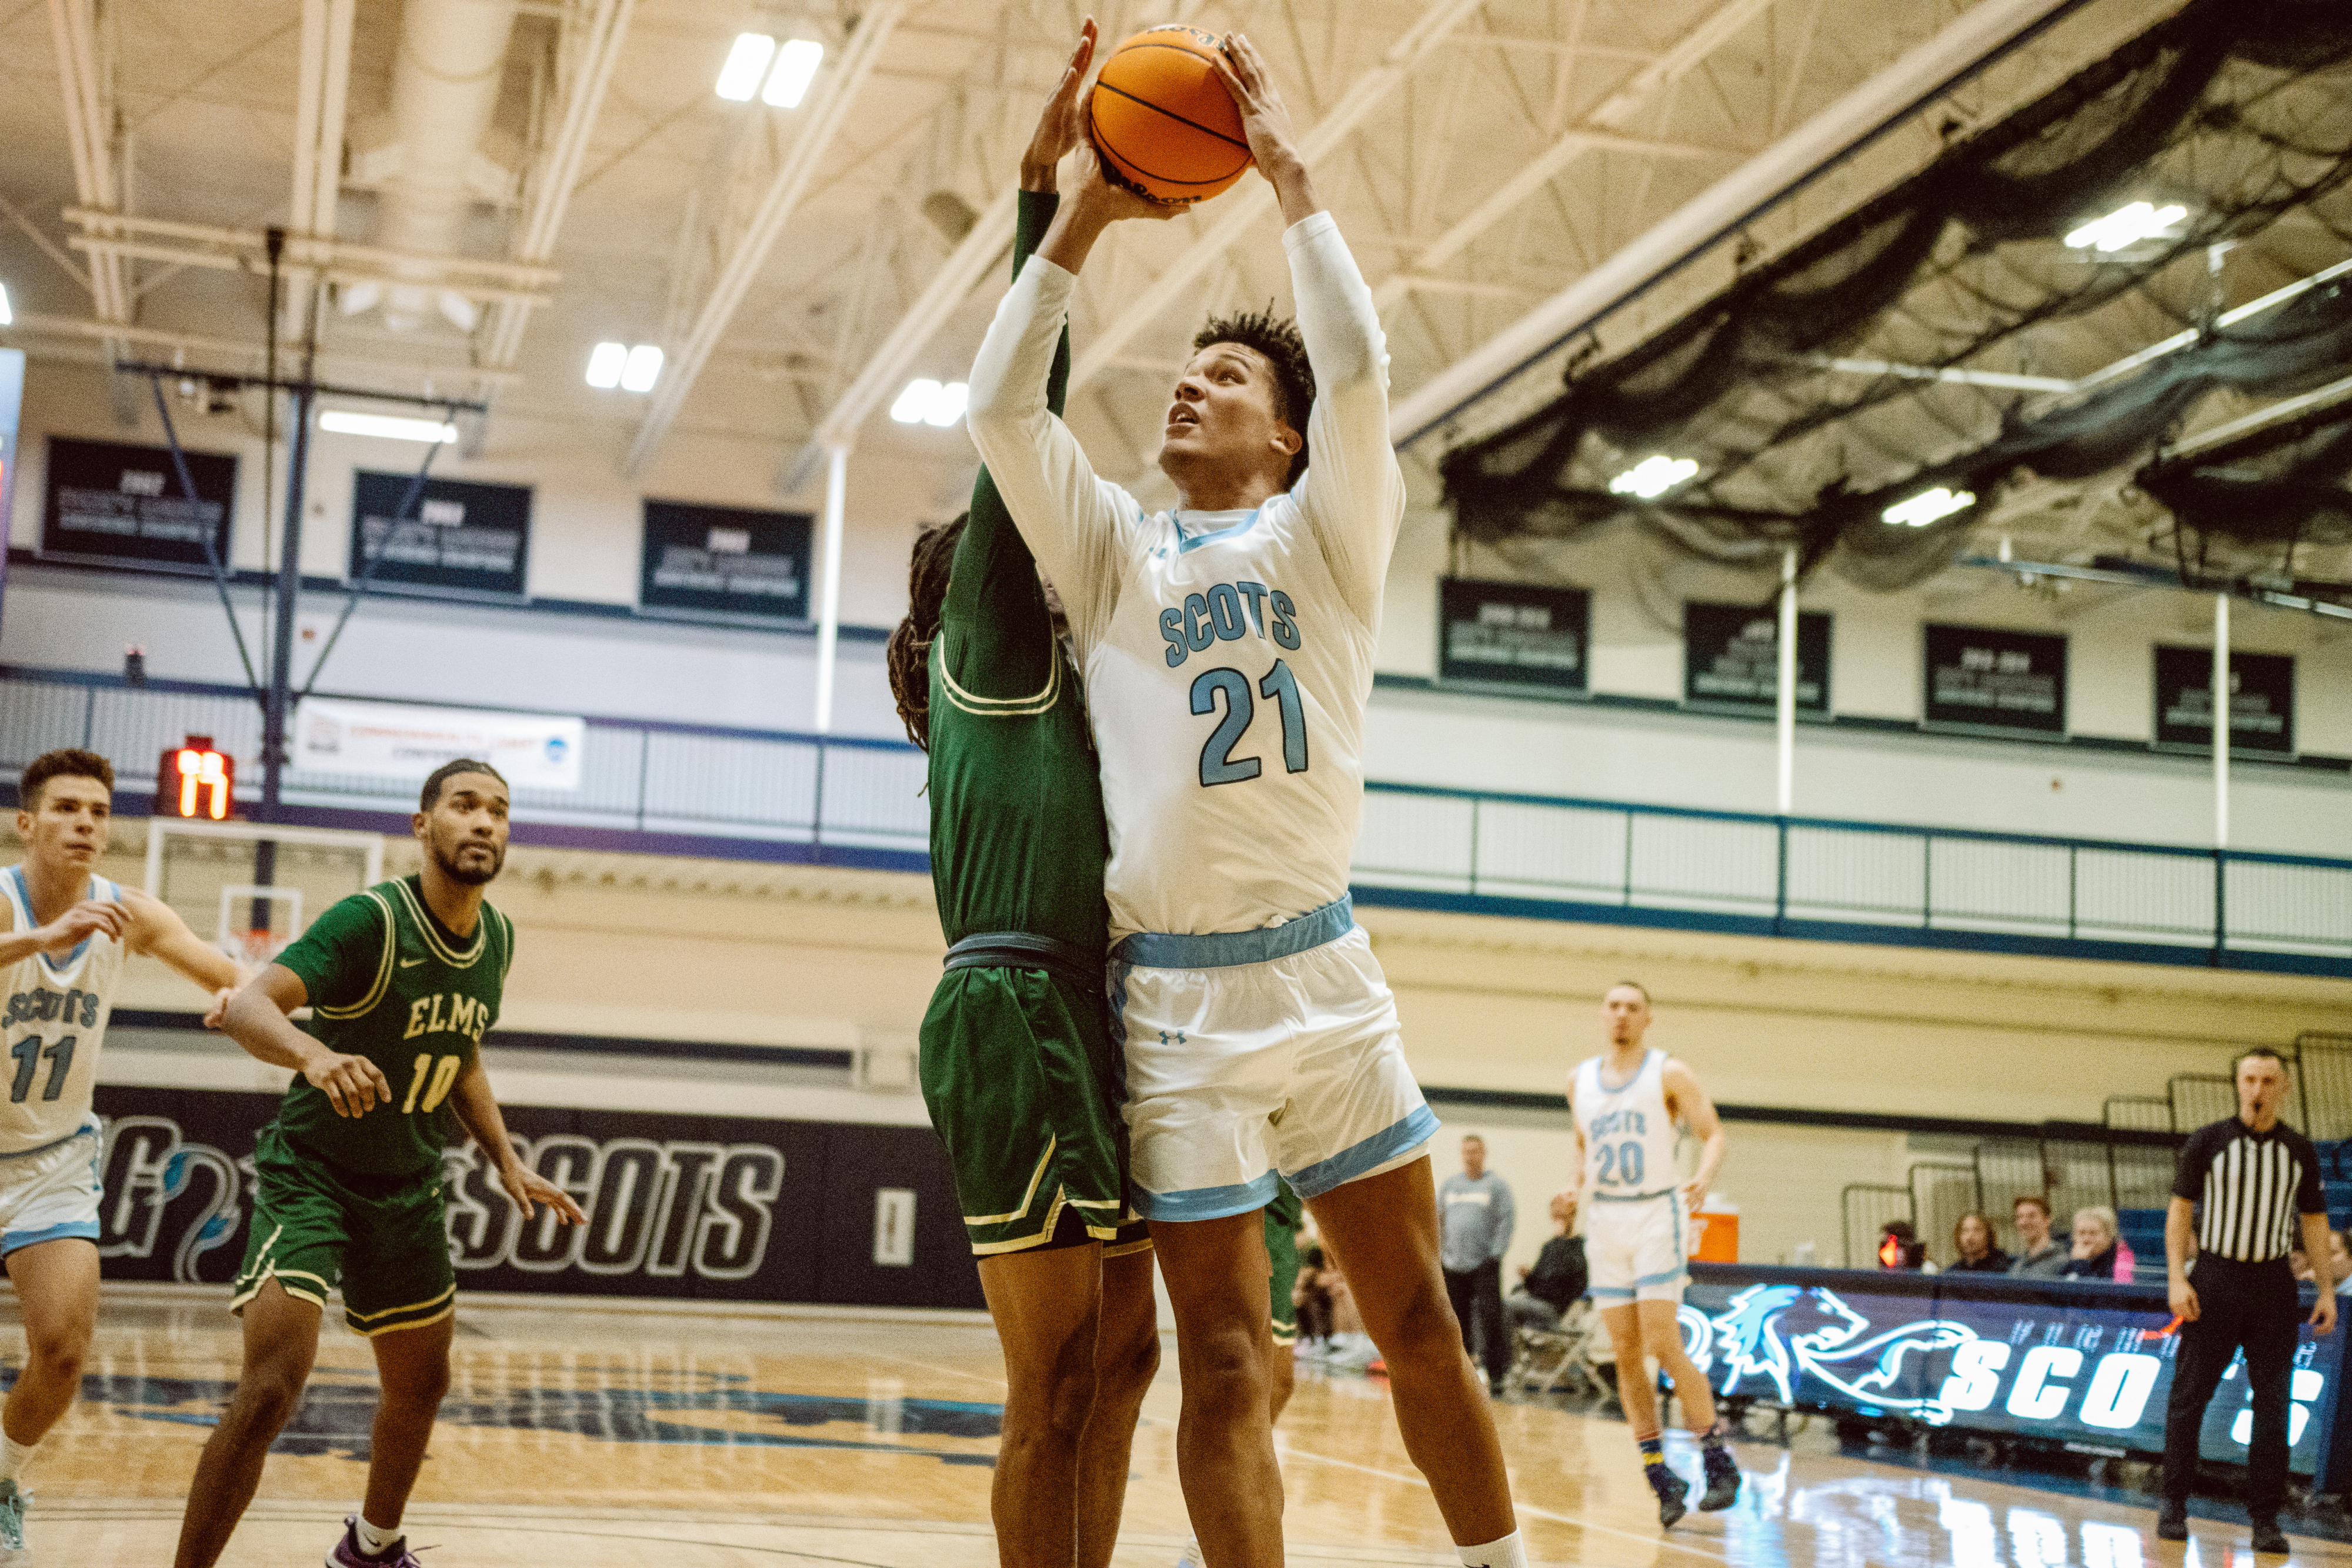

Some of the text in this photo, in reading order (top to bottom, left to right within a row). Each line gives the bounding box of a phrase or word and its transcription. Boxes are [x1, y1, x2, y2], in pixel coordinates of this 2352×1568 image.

[1159, 581, 1302, 668] SCOTS
[1189, 658, 1309, 788] 21
[2, 987, 99, 1029] SCOTS
[403, 992, 489, 1040] ELMS
[11, 1035, 76, 1103] 11
[402, 1053, 461, 1114] 10
[1594, 1141, 1644, 1187] 20
[449, 1133, 785, 1280] SCOTS
